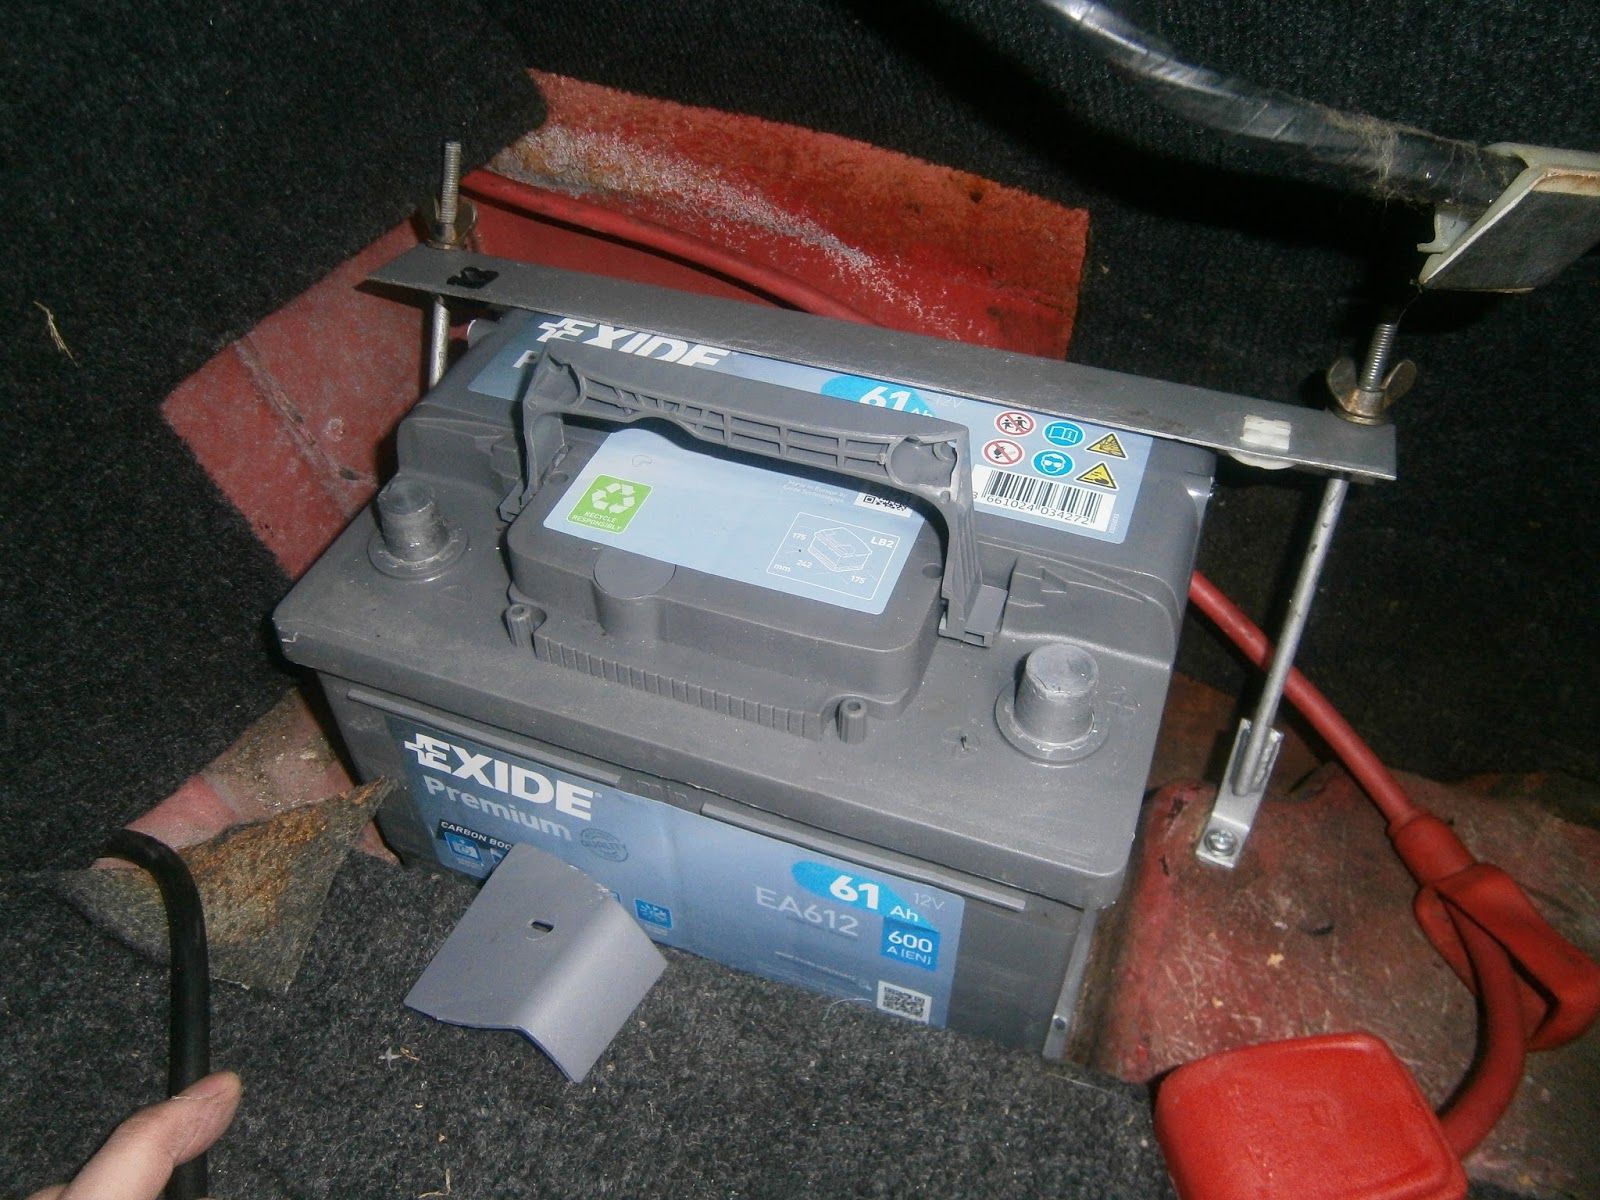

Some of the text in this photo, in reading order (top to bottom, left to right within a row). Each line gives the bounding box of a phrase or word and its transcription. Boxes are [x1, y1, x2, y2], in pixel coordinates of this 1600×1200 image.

[536, 317, 731, 367] EXIDE
[859, 385, 912, 412] 61
[584, 511, 617, 523] RECYCLE
[986, 495, 1034, 512] 661024
[1040, 506, 1090, 526] 034272
[571, 514, 622, 531] RESPONSIBLY
[792, 532, 807, 541] 175
[870, 536, 895, 549] LB2
[773, 563, 791, 573] mm
[796, 559, 813, 569] 242
[850, 575, 866, 585] 175
[404, 733, 595, 821] EXIDE
[422, 775, 573, 841] Premium
[440, 821, 488, 843] CARBON
[829, 874, 919, 922] 61 Ah
[912, 892, 945, 911] 12V
[755, 885, 860, 938] EA612
[886, 945, 898, 955] A
[888, 930, 933, 954] 600
